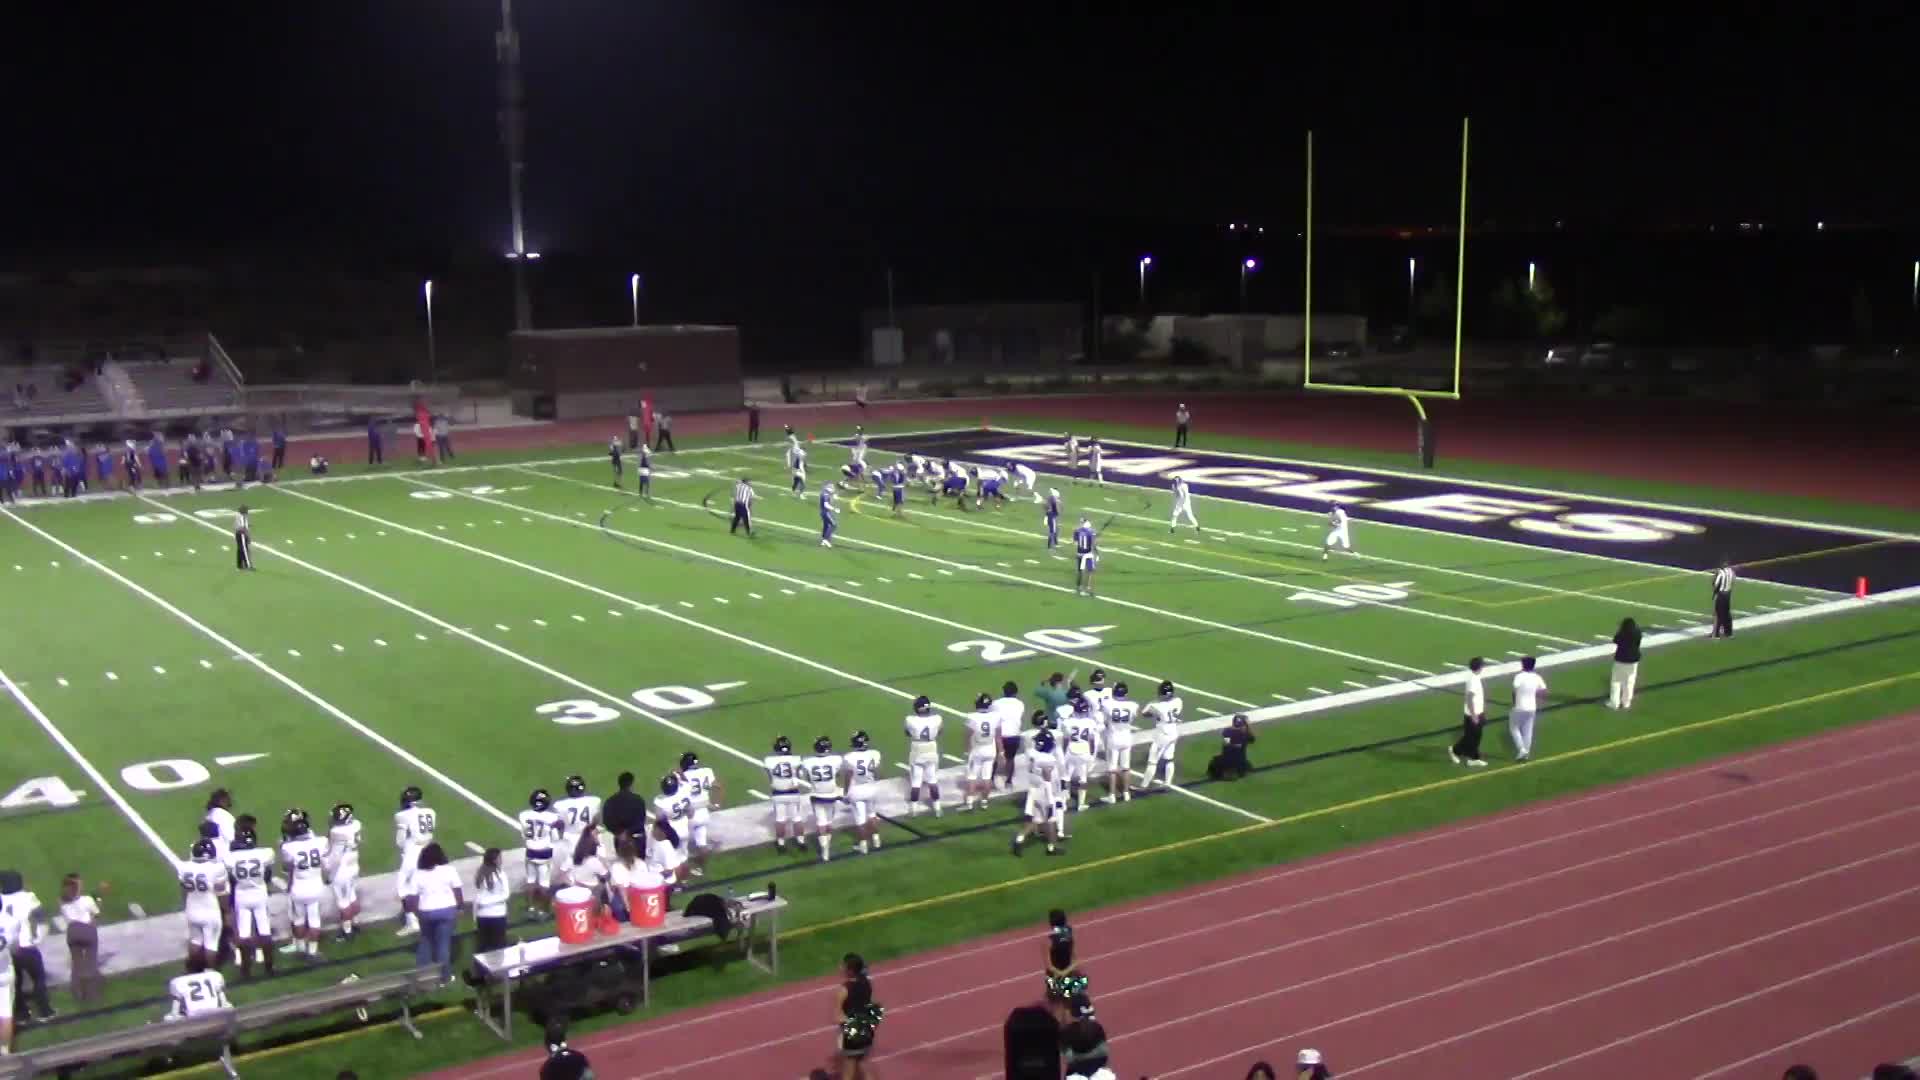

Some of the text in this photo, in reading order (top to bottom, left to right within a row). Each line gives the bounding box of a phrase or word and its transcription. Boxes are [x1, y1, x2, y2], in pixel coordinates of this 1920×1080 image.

[1287, 583, 1408, 607] 10
[946, 627, 1103, 662] 20
[535, 685, 714, 725] 30
[920, 726, 930, 741] 4
[981, 721, 990, 737] 9
[1071, 727, 1089, 742] 24
[773, 763, 792, 778] 43
[812, 765, 832, 782] 53
[568, 806, 590, 825] 74
[526, 820, 544, 839] 37
[297, 848, 320, 870] 28
[235, 859, 261, 880] 62
[188, 980, 215, 1001] 21
